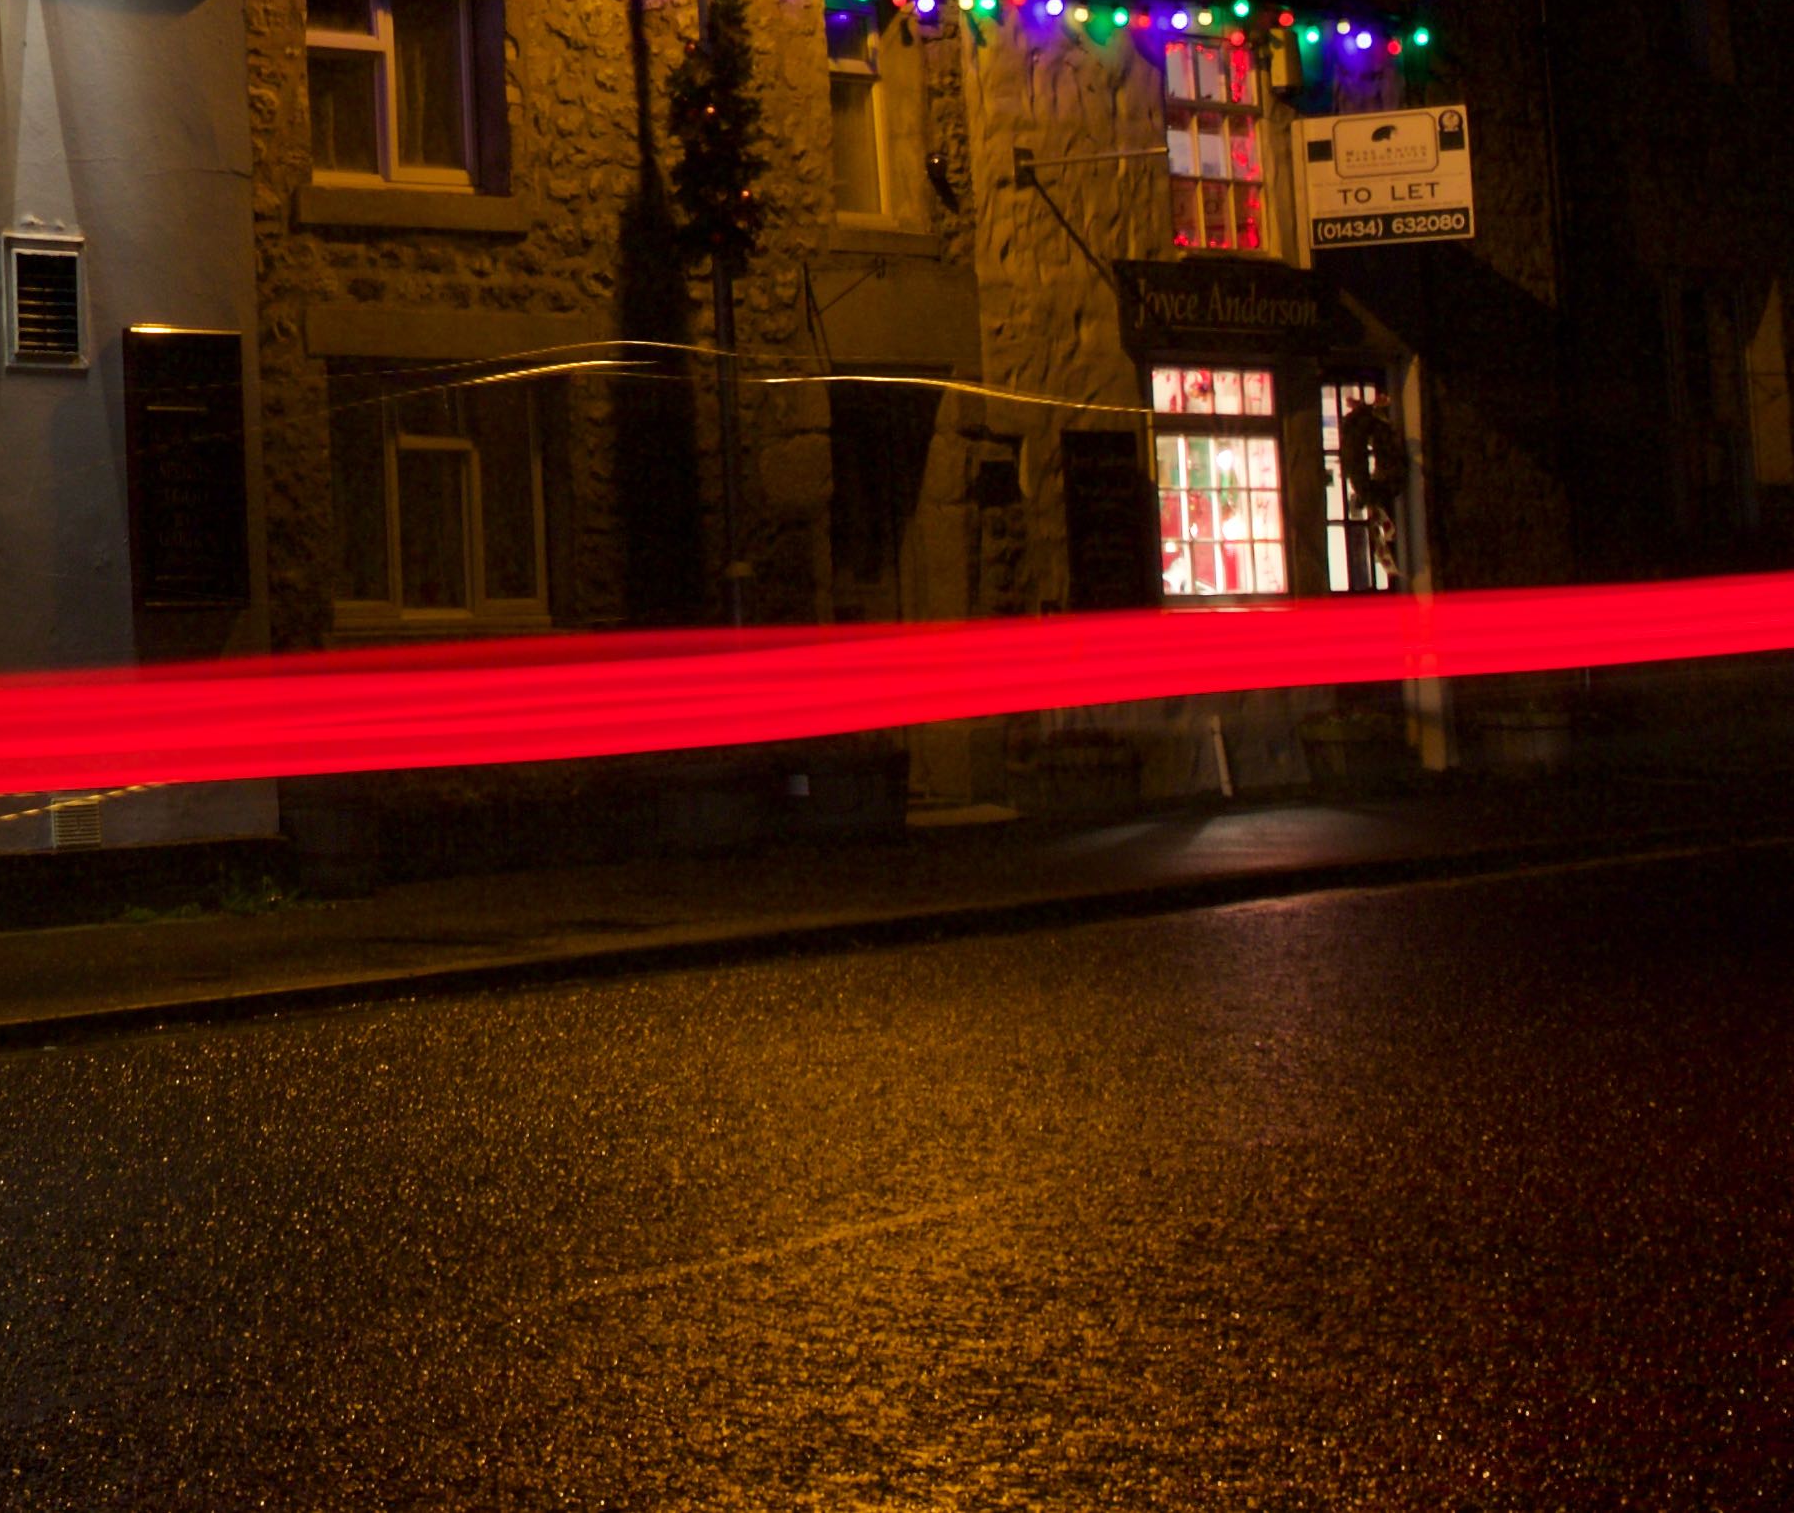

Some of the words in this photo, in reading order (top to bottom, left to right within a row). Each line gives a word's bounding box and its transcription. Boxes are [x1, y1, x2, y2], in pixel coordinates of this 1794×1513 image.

[1338, 187, 1372, 205] TO
[1391, 182, 1440, 201] LET
[1316, 219, 1384, 242] (01434)
[1391, 213, 1466, 235] 632080
[1207, 281, 1318, 326] Anderson
